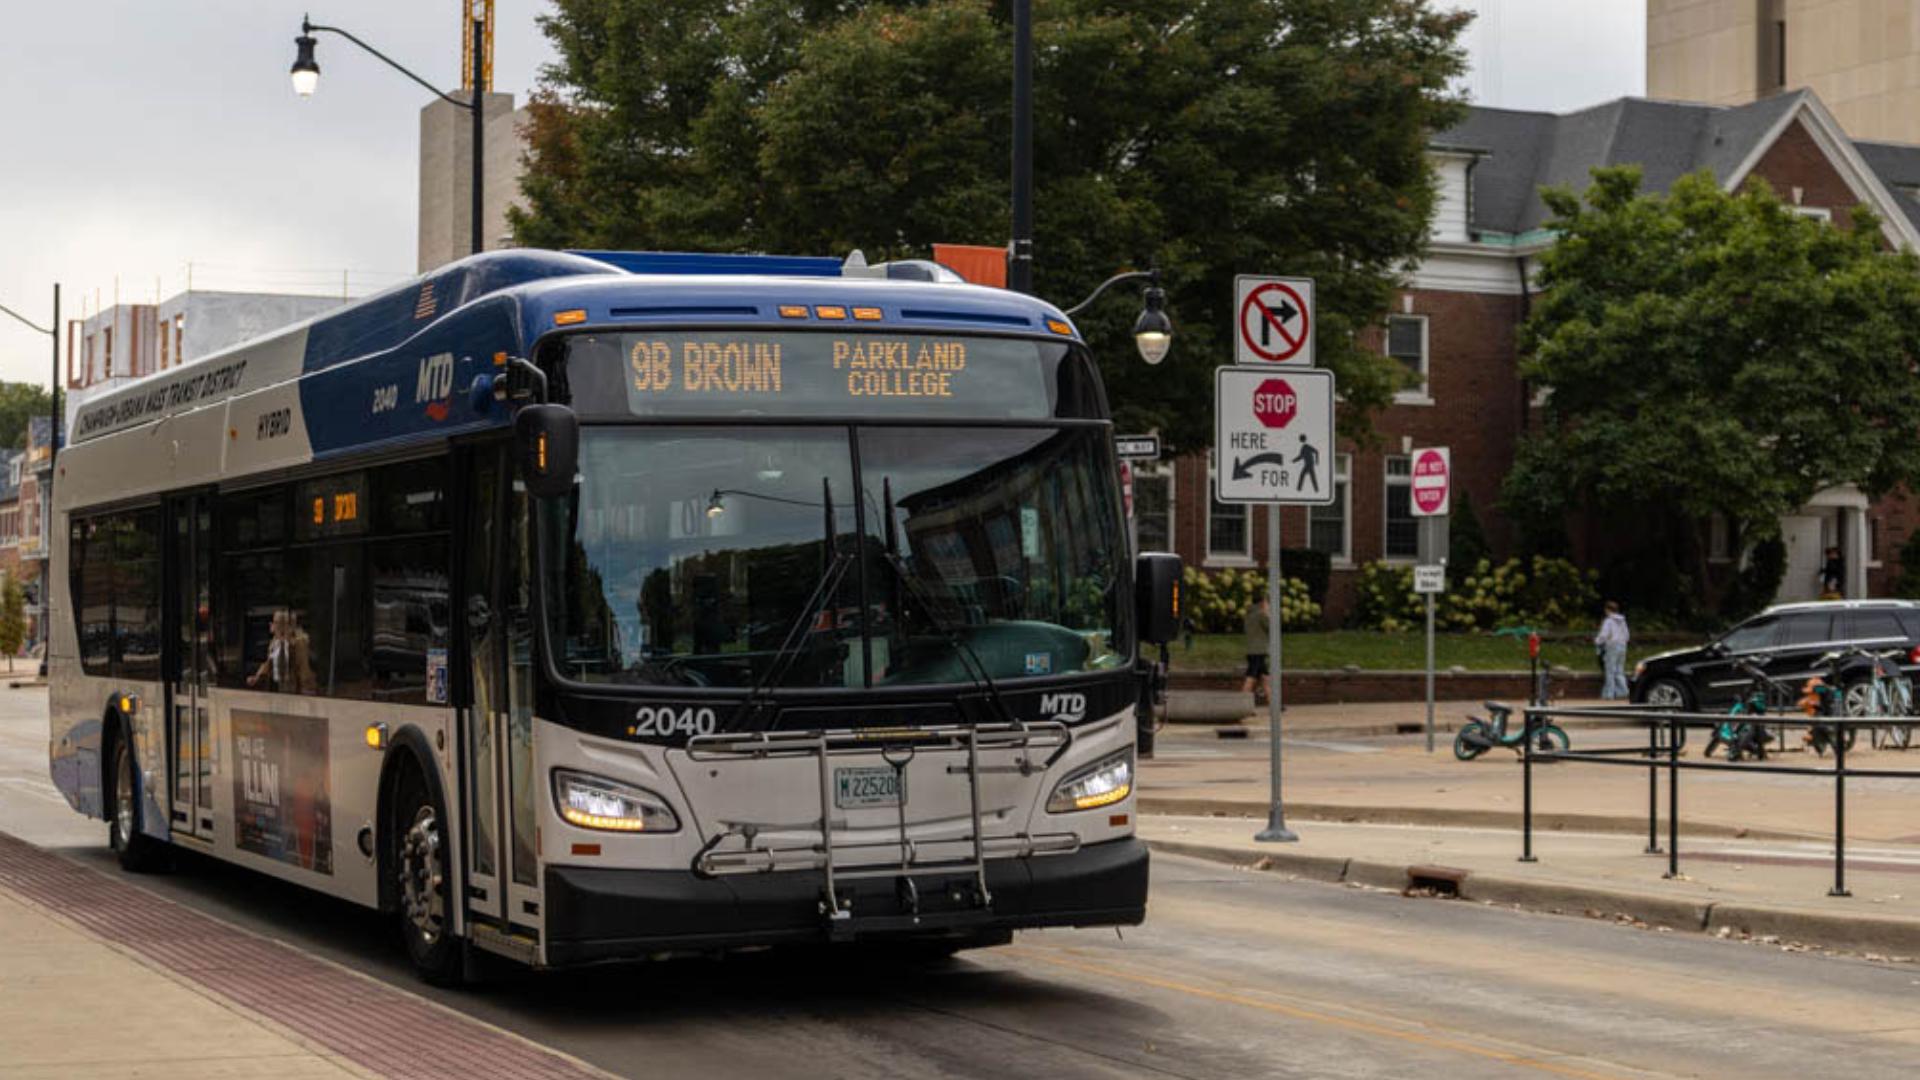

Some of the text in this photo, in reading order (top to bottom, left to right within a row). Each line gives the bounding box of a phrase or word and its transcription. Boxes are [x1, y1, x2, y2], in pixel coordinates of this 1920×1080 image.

[416, 351, 454, 404] MTD
[631, 341, 967, 392] 9B BROWN PARKLAND
[163, 374, 206, 407] TRANSIT
[200, 358, 248, 399] DISTRICT
[848, 371, 954, 396] COLLEGE
[372, 383, 398, 413] 2040
[1254, 394, 1296, 413] STOP
[257, 407, 292, 441] HYBRID
[1230, 432, 1268, 450] HERE
[1261, 469, 1289, 488] FOR
[1040, 693, 1086, 715] MTD
[635, 706, 717, 736] 2040
